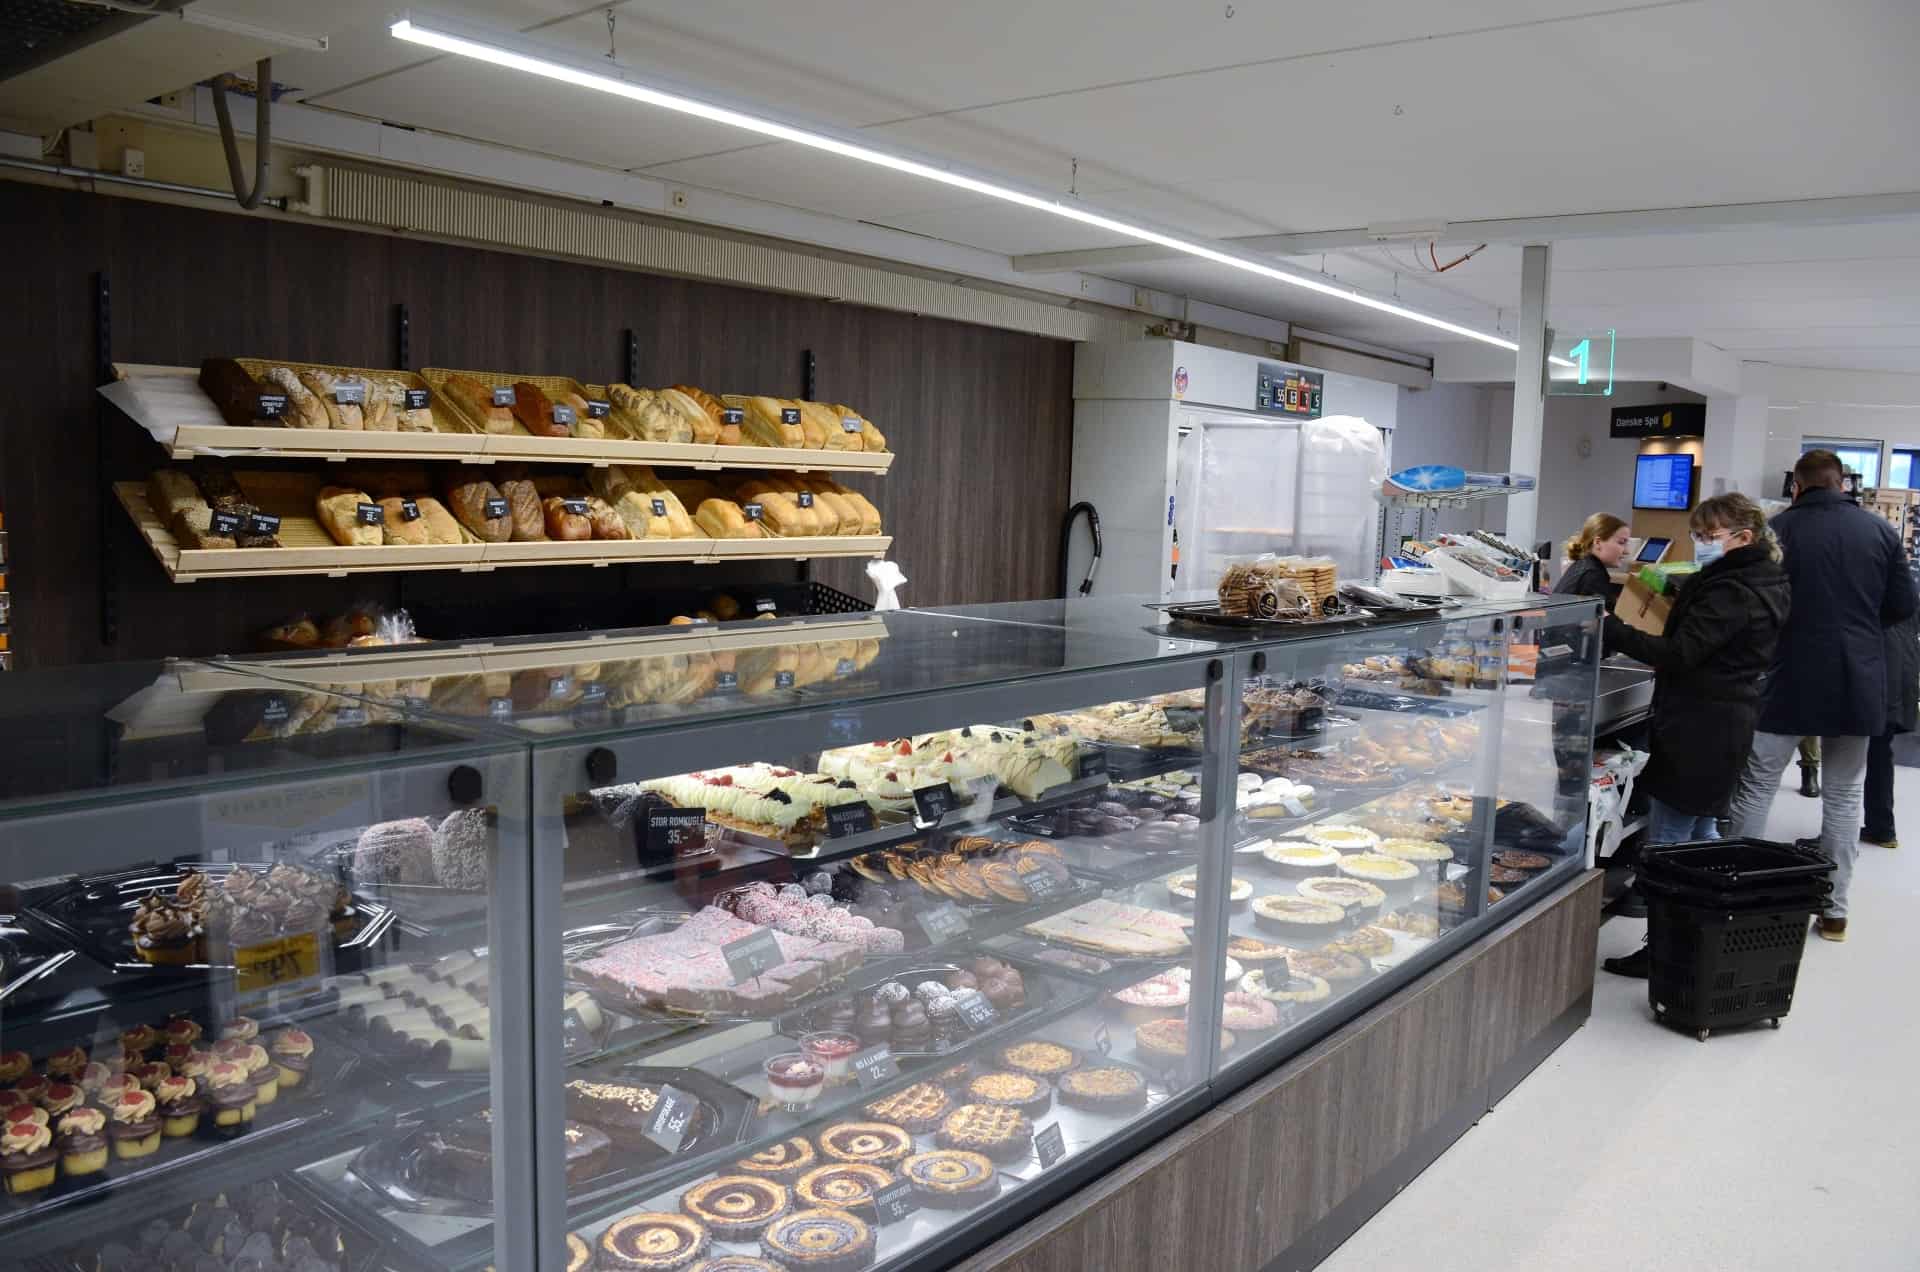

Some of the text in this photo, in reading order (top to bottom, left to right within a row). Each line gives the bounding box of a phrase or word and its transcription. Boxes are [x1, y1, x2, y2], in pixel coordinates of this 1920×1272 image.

[1569, 339, 1590, 385] 1
[1616, 415, 1659, 428] Danske Spil
[650, 815, 705, 827] STOR ROMKUGLE
[667, 829, 689, 845] 35.-
